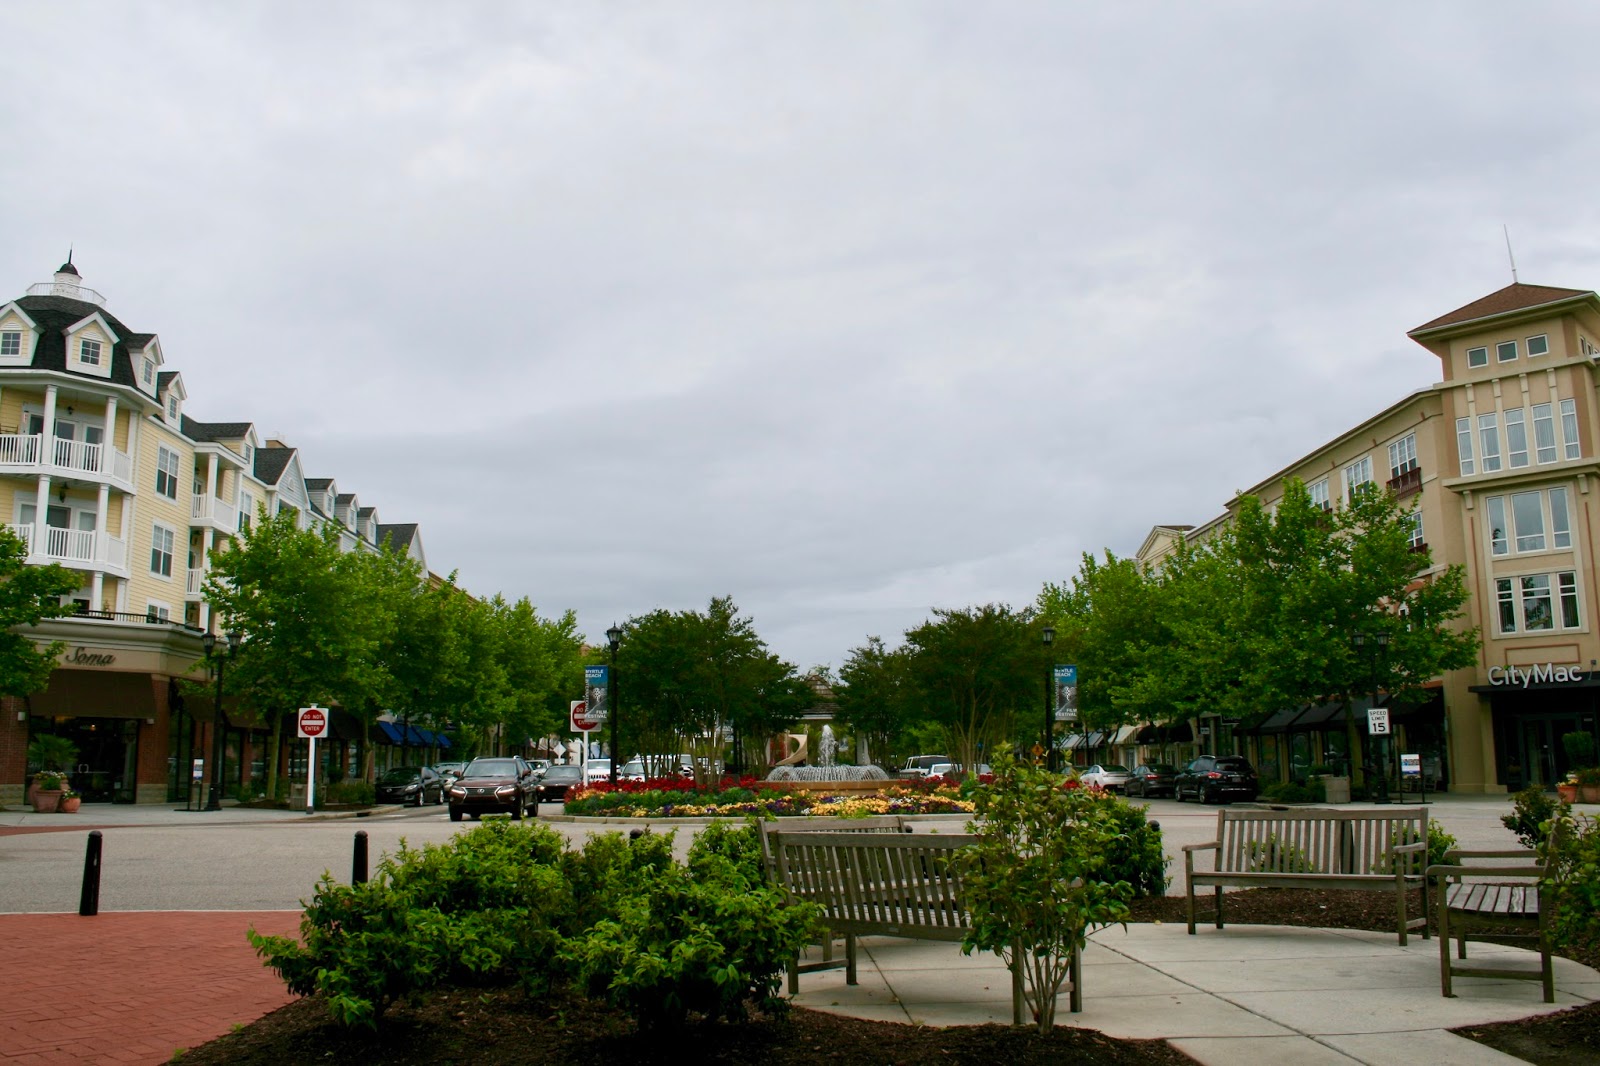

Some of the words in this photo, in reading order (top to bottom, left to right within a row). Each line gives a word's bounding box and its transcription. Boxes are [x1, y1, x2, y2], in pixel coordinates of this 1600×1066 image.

[65, 647, 116, 664] Soma
[1488, 662, 1582, 688] CityMac
[1373, 723, 1386, 732] 15
